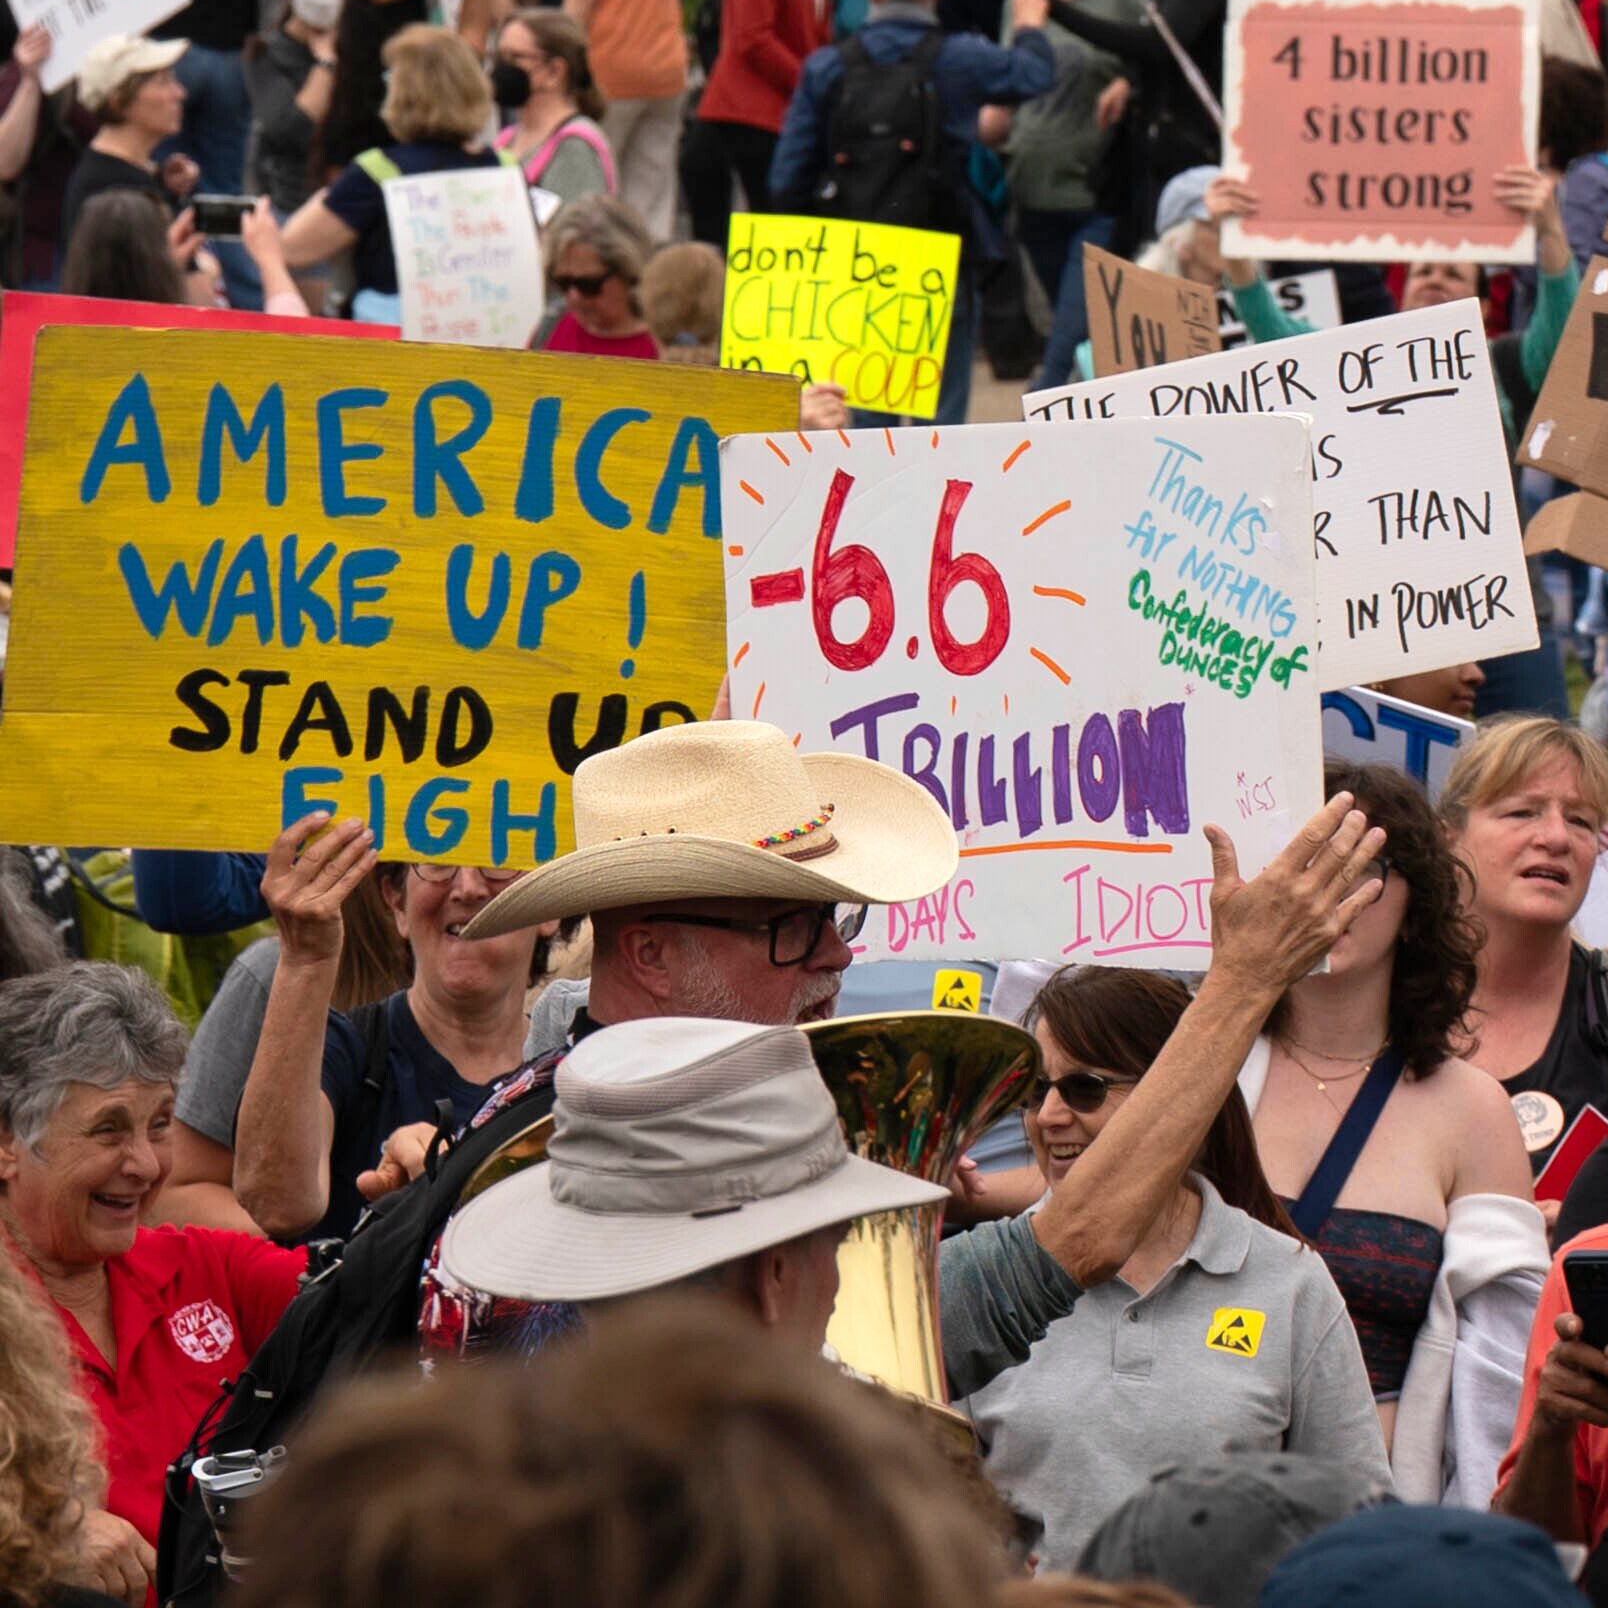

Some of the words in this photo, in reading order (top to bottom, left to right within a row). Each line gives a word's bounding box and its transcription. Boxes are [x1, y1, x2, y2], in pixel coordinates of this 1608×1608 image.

[1272, 35, 1305, 80] 4
[1330, 34, 1488, 84] billion
[1302, 101, 1473, 144] sisters
[1304, 168, 1475, 217] strong
[852, 228, 898, 288] be
[921, 267, 947, 298] a
[730, 274, 948, 354] CHICKEN
[728, 346, 762, 372] in
[830, 347, 942, 410] COUP
[1338, 344, 1391, 395] OF
[1396, 328, 1479, 385] THE
[80, 371, 722, 539] AMERICA
[1149, 436, 1268, 557] Thanks
[1367, 488, 1493, 547] THAN
[118, 532, 402, 650] WAKE
[445, 543, 582, 652] UP
[1128, 567, 1276, 684] Confederacy
[1268, 644, 1310, 692] of
[1177, 543, 1298, 639] NOTHING
[1345, 596, 1380, 640] IN
[1391, 574, 1516, 654] POWER
[169, 666, 494, 770] STAND
[830, 692, 1191, 839] TRILLION
[177, 1305, 216, 1337] CWA
